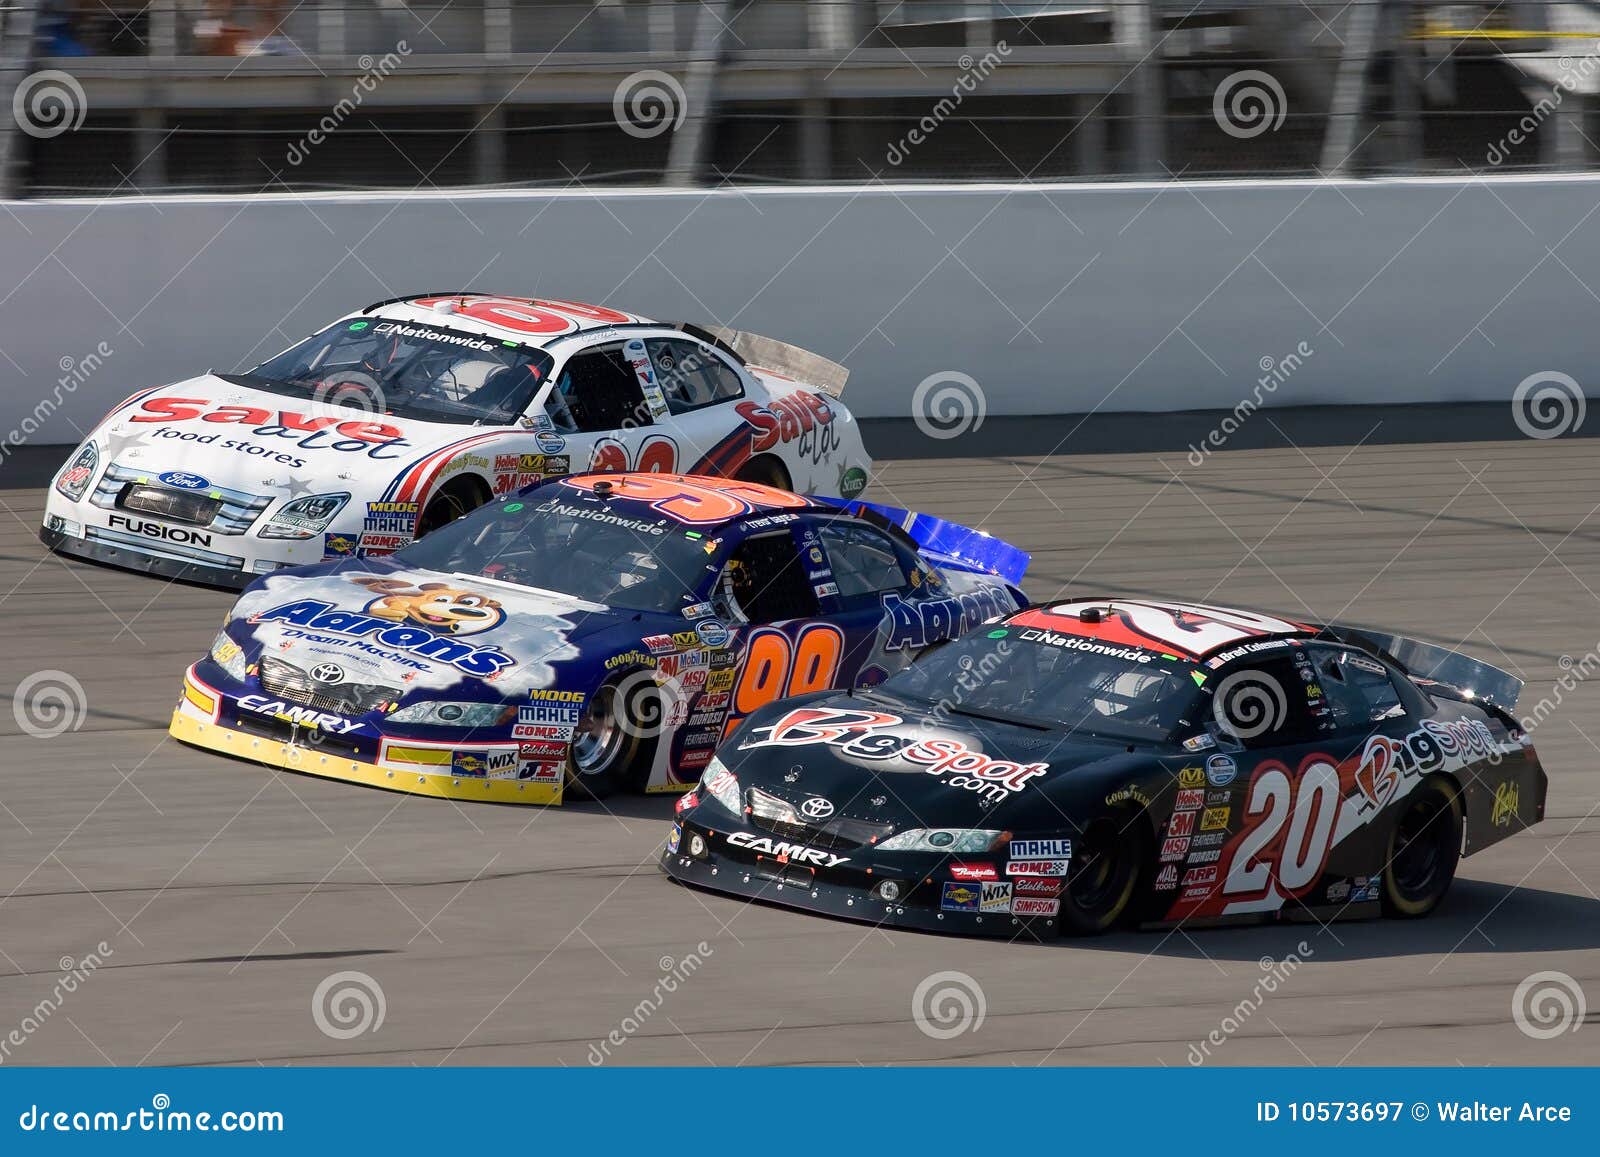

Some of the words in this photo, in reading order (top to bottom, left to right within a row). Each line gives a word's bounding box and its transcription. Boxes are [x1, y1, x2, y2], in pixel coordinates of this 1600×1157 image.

[391, 324, 495, 351] Nationwide
[129, 397, 405, 443] Save
[735, 389, 837, 452] Save
[151, 427, 222, 444] food
[220, 437, 306, 468] stores
[166, 472, 201, 489] Ford
[493, 474, 517, 494] 3M
[369, 503, 419, 513] MOOG
[364, 518, 415, 532] MAHLE
[551, 504, 664, 536] Nationwide
[108, 514, 212, 547] FUSION
[362, 535, 400, 546] COMP
[258, 599, 513, 677] Aaron's
[281, 627, 347, 647] Dream
[351, 640, 434, 673] Machine
[1039, 631, 1153, 664] Nationwide
[1219, 647, 1248, 662] Brad
[1244, 640, 1288, 652] Coleman
[604, 650, 657, 669] GOODYEAR
[658, 655, 679, 677] 3M
[680, 653, 700, 666] Mobil
[702, 652, 708, 664] 1
[682, 670, 707, 685] MSD
[530, 689, 586, 702] MOOG
[696, 694, 728, 707] ARP
[237, 694, 366, 735] CAMRY
[520, 707, 578, 723] MAHLE
[688, 711, 725, 726] MOROSO
[514, 726, 558, 737] COMP
[522, 743, 566, 757] Edelbrock
[738, 708, 1050, 792] BigSpot
[454, 759, 486, 767] SUNOCO
[488, 752, 517, 769] WIX
[519, 762, 559, 779] JE
[708, 771, 737, 796] 20
[940, 774, 1010, 802] .com
[1105, 784, 1151, 808] GOODYEAR
[1169, 813, 1194, 835] 3M
[1223, 761, 1340, 894] 20
[726, 832, 852, 867] CAMRY
[1011, 841, 1070, 856] MAHLE
[1163, 839, 1188, 854] MSD
[1009, 862, 1053, 873] COMP
[1183, 868, 1217, 882] ARP
[982, 884, 1010, 902] WIX
[1016, 880, 1060, 893] Edelbrock
[1156, 882, 1177, 890] TOOLS
[1014, 901, 1056, 913] SIMPSON
